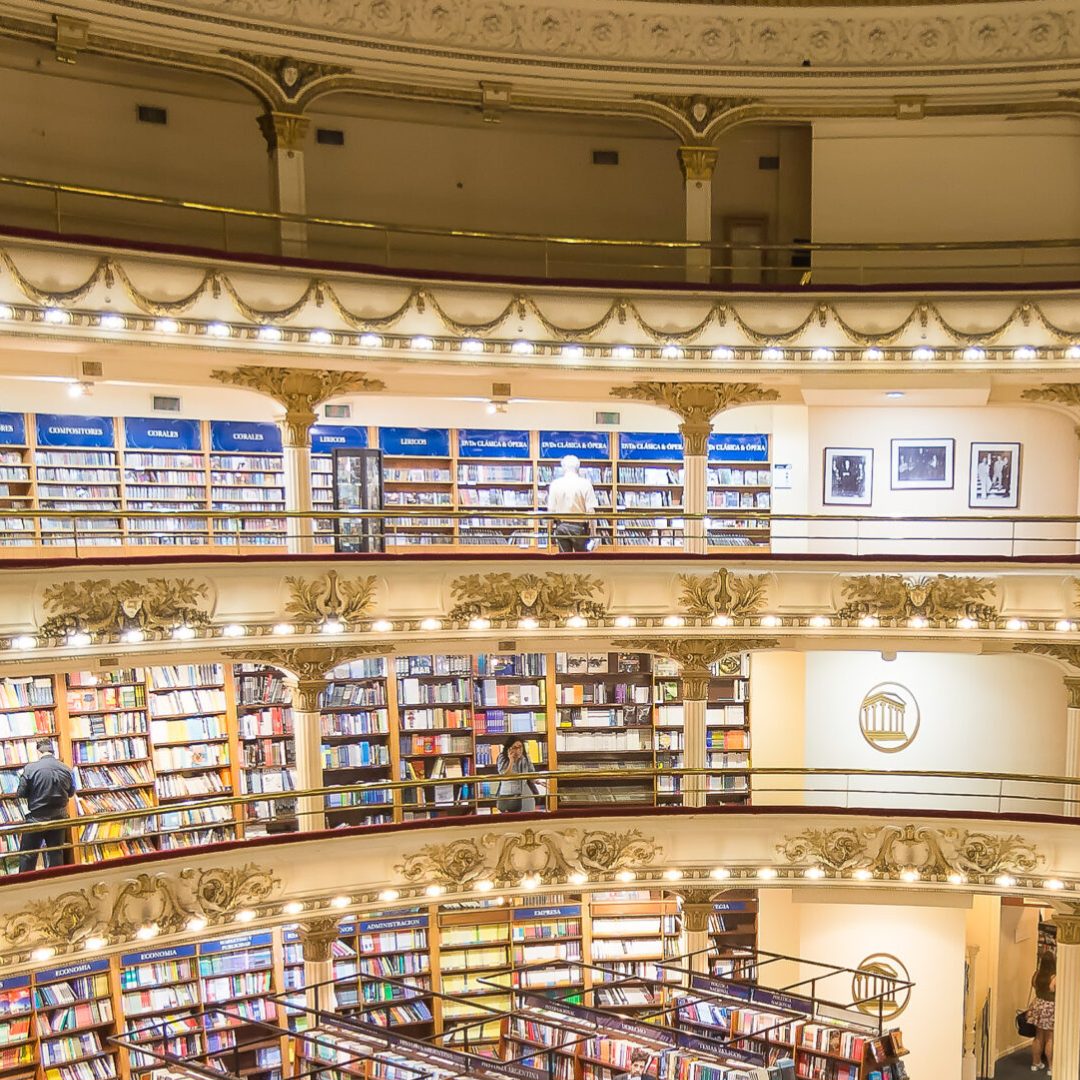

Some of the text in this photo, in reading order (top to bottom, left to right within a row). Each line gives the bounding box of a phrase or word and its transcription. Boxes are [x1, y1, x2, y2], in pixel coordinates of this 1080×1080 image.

[49, 426, 103, 436] COMPOSITORES
[147, 430, 178, 438] CORALES
[366, 919, 420, 930] ADMINISTRACION
[140, 950, 177, 960] ECONOMIA
[56, 964, 91, 976] ECONOMIA
